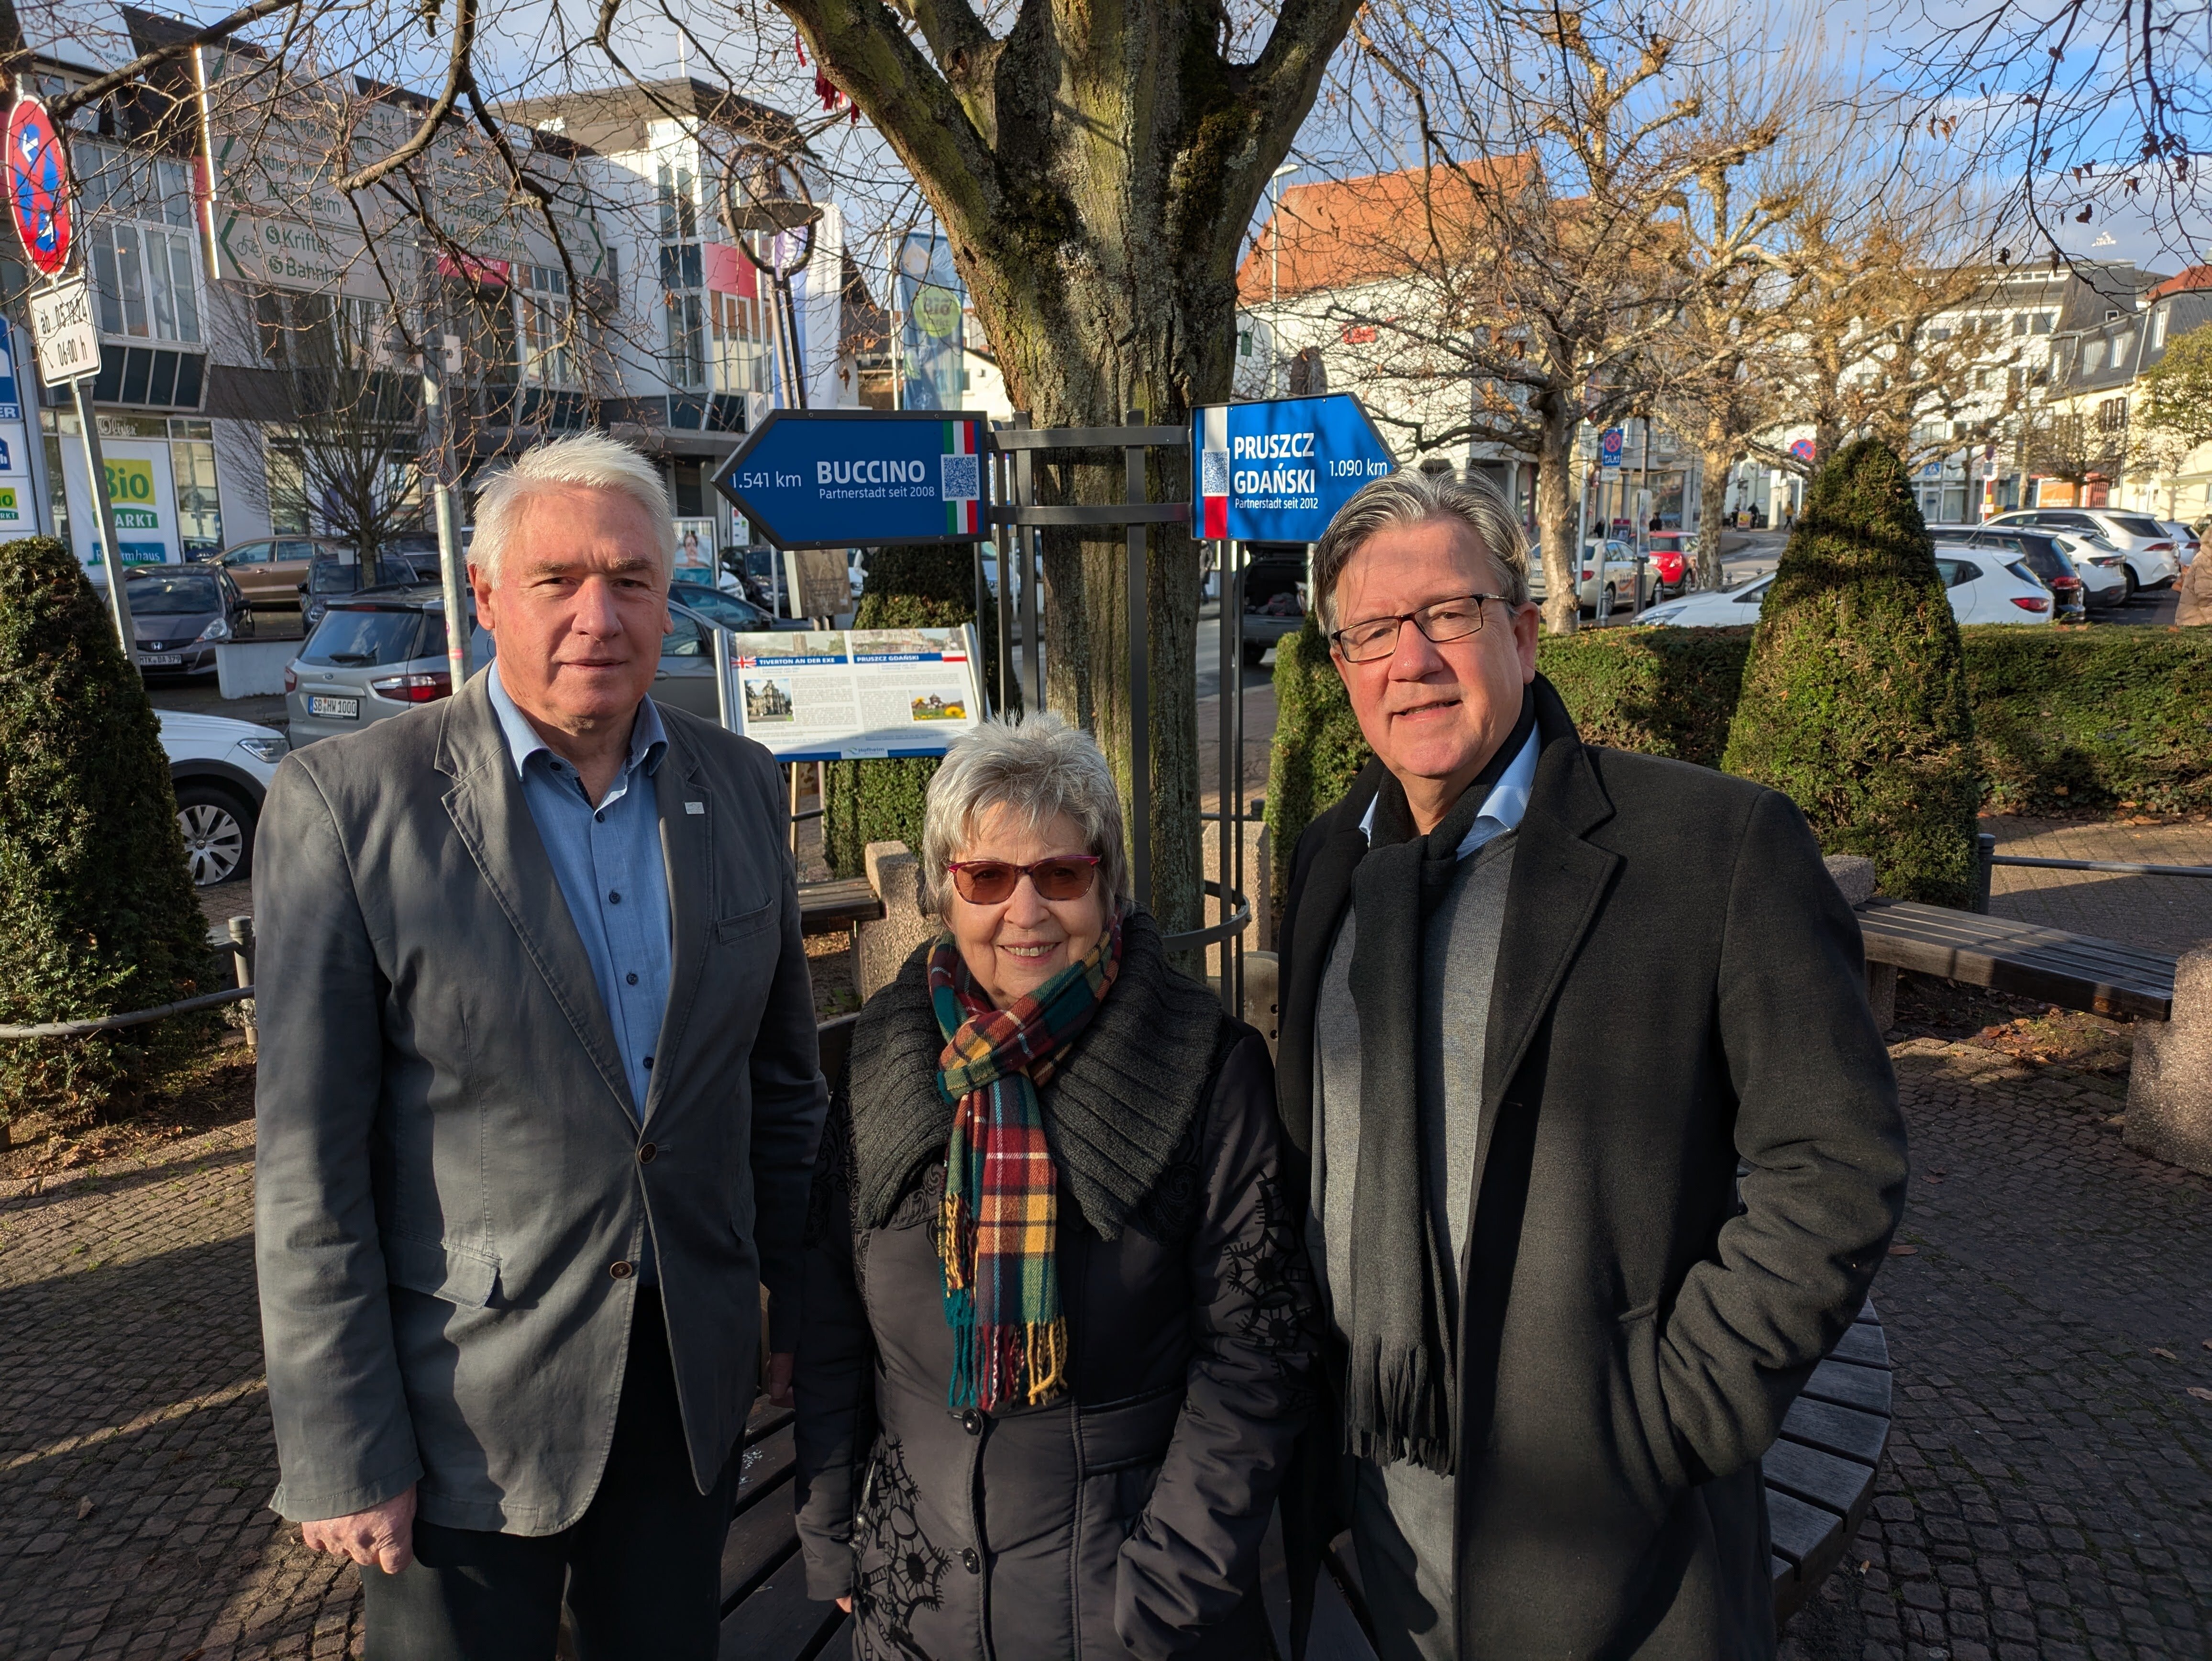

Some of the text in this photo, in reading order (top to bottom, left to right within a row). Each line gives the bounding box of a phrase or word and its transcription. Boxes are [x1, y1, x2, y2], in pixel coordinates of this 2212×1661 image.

[282, 229, 331, 255] Kriftel
[287, 256, 346, 286] Bahnho
[41, 297, 88, 334] ab 05.12.24
[57, 335, 88, 366] 06:00 h
[1234, 432, 1315, 459] PRUSZCZ
[732, 460, 926, 488] 1.541 km BUCCINO
[1234, 457, 1388, 495] GDAŃSKI 1.090 km
[819, 486, 935, 499] Partnerstadt seit 2008
[1235, 497, 1318, 509] Partnerstadt seit 2012
[115, 513, 153, 527] ARKT
[95, 547, 160, 563] Rrmhaus
[314, 698, 356, 714] SB HW 1000
